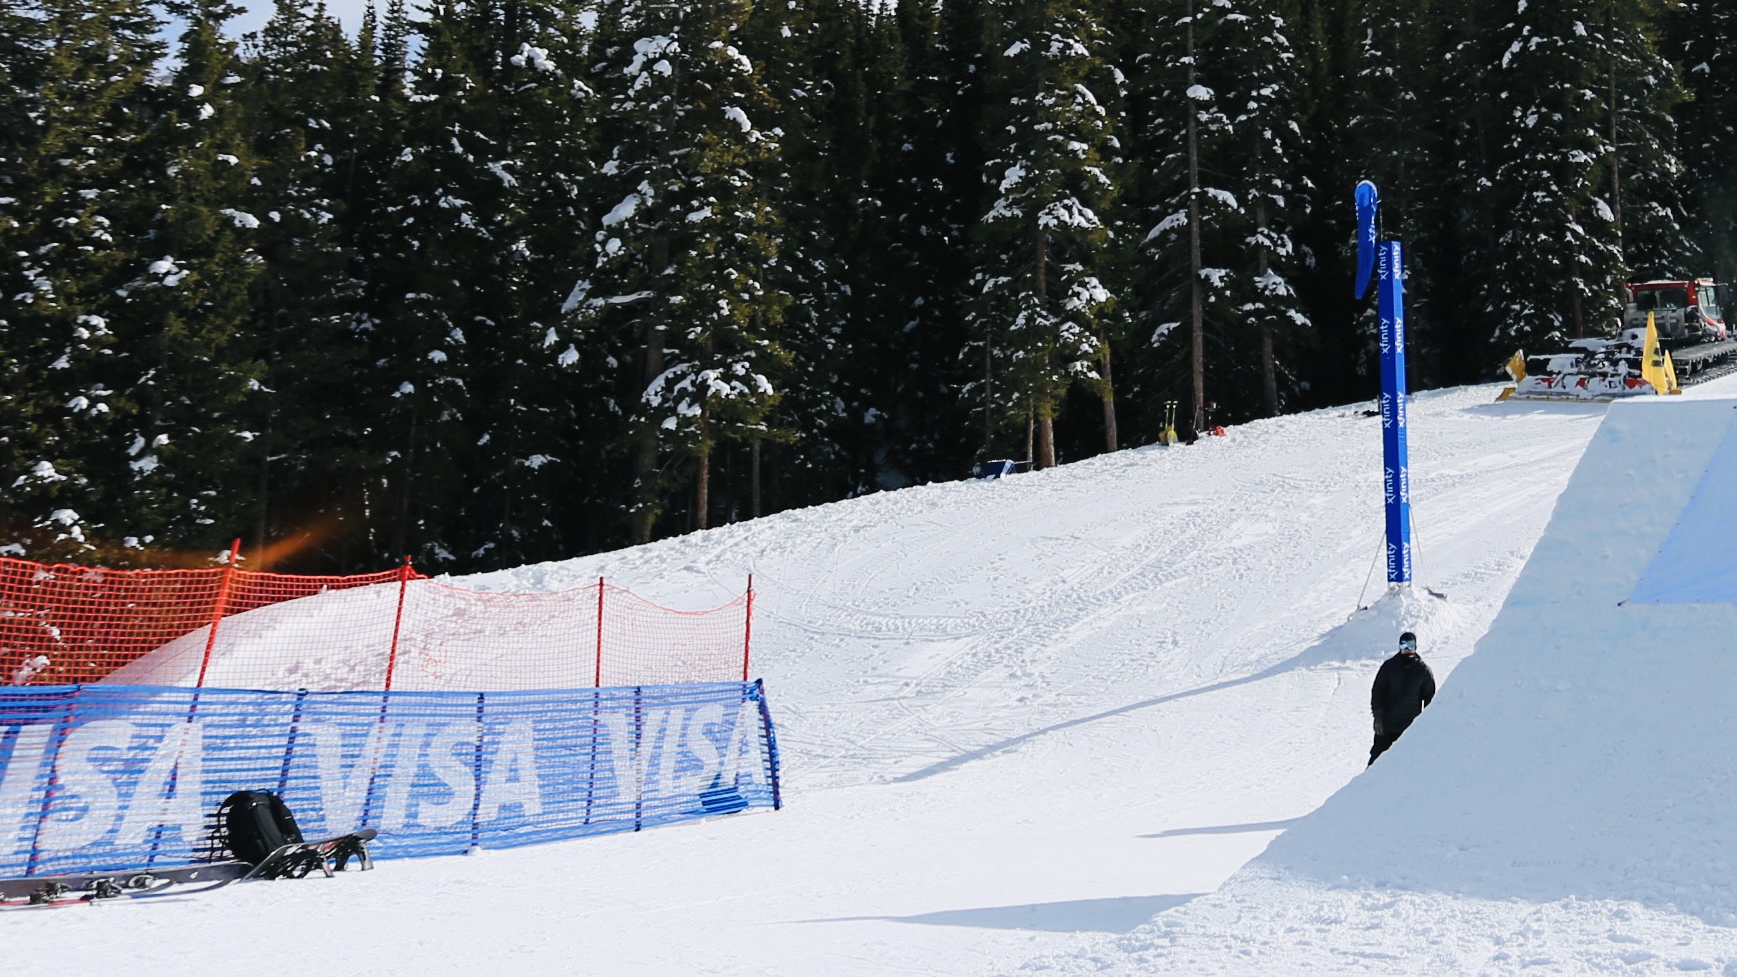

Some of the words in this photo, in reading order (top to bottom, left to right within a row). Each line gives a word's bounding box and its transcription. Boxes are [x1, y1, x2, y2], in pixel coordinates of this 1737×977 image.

[1377, 245, 1389, 280] xfinity
[1392, 244, 1401, 280] xfinity
[1379, 318, 1391, 354] xfinity
[1395, 317, 1403, 354] xfinity
[1381, 392, 1392, 429] xfinity
[1397, 391, 1405, 428] xfinity
[1385, 467, 1396, 504] xfinity
[1399, 466, 1408, 504] xfinity
[1388, 543, 1398, 580] xfinity
[1402, 542, 1410, 580] xfinity
[0, 720, 204, 852] ISA
[297, 721, 543, 835] VISA
[590, 704, 766, 800] VISA
